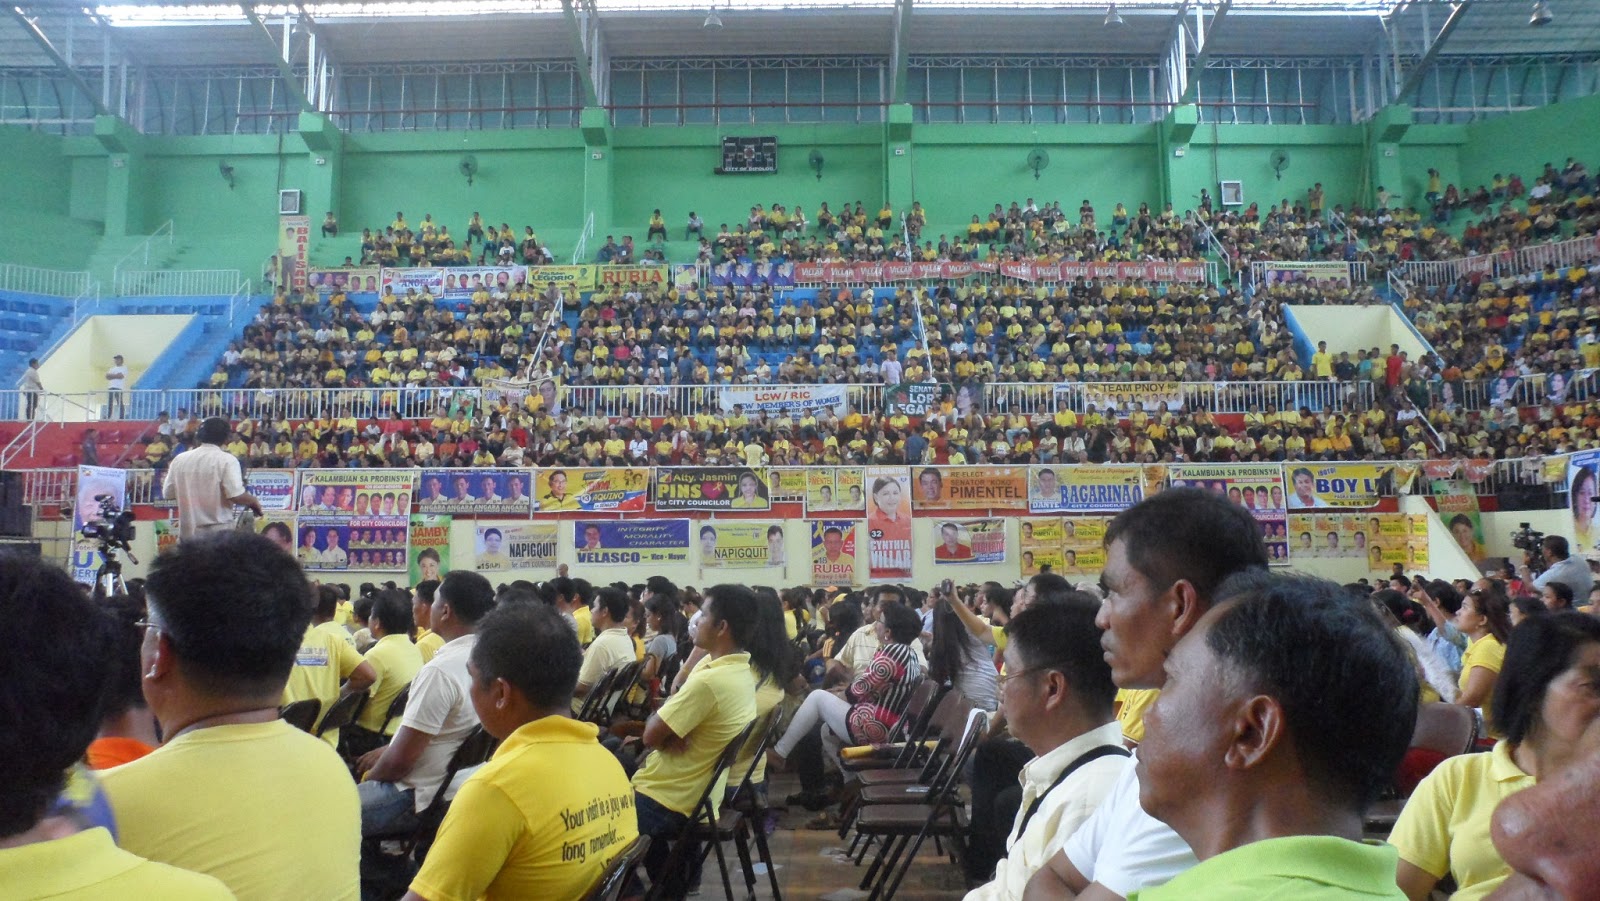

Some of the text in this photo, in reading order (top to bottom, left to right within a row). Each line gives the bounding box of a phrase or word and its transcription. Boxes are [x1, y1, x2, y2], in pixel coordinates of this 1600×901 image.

[801, 268, 824, 276] VILLAR
[831, 268, 854, 276] VILLAR
[1066, 266, 1088, 275] VILLAR
[603, 269, 663, 284] RUBIA
[1102, 383, 1165, 392] TEAM PNOY
[755, 393, 781, 401] LCW
[790, 391, 811, 399] RIC
[1182, 467, 1281, 477] KALAMBUAN SA PROBINSYA!
[315, 474, 411, 483] KALAMBUAN SA PROBINSYA!
[674, 473, 737, 482] Atty. Jasmin
[1132, 476, 1140, 484] 5
[1315, 478, 1358, 493] BOY
[657, 484, 702, 498] PINS
[950, 486, 1022, 498] PIMENTEL
[1061, 484, 1142, 507] BAGARINAO
[592, 492, 625, 501] AQUINO
[1032, 501, 1060, 509] DANTE
[411, 526, 449, 538] JAMBY
[410, 538, 448, 547] MADRIGAL
[870, 540, 910, 550] CYNTHIA
[509, 542, 557, 558] NAPIGQUIT
[714, 547, 768, 559] NAPIGQUIT
[577, 552, 640, 563] VELASCO
[871, 550, 911, 568] VILLAR
[814, 564, 854, 573] RUBIA
[560, 808, 585, 831] Your
[586, 797, 600, 822] visit
[598, 797, 606, 816] is
[608, 793, 620, 820] joy
[620, 794, 629, 810] we
[561, 841, 586, 864] long
[589, 823, 626, 855] remember...
